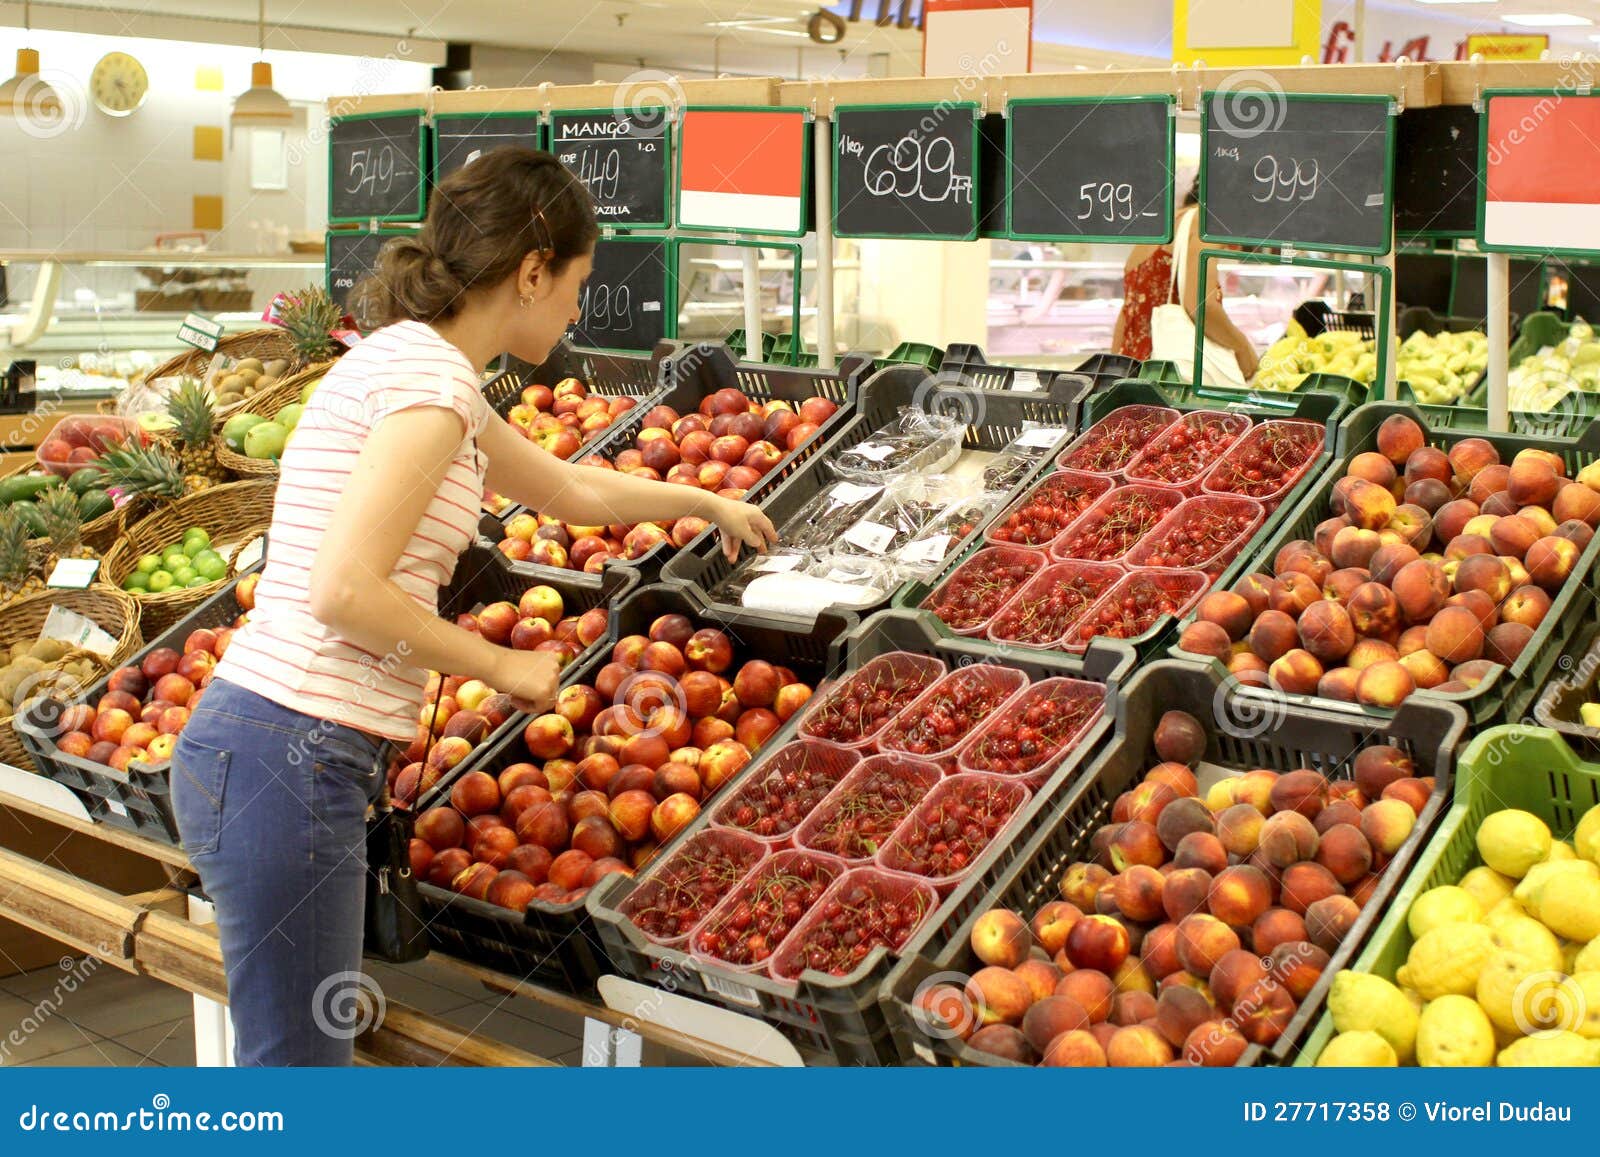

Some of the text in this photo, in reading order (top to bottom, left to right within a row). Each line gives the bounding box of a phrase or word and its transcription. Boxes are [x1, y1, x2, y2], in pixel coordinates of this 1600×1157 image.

[562, 117, 631, 139] MANGÓ
[864, 137, 955, 201] 699
[1251, 155, 1319, 203] 999
